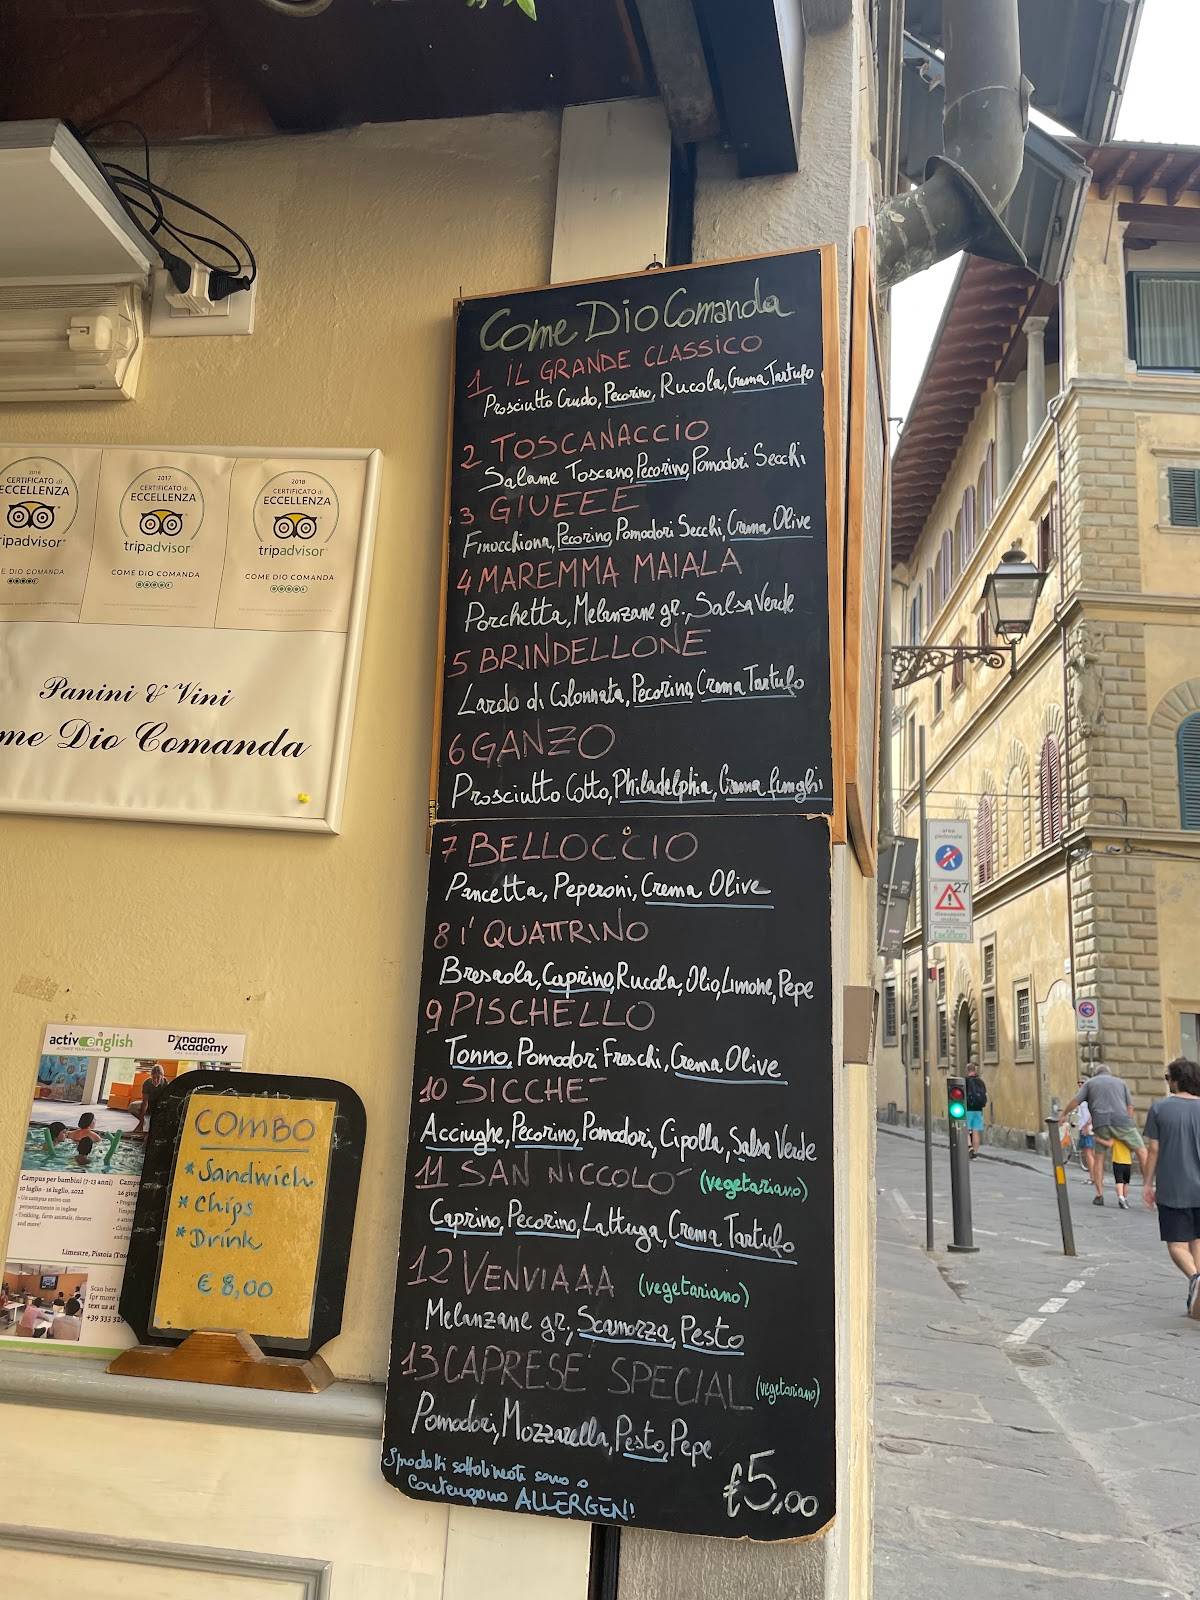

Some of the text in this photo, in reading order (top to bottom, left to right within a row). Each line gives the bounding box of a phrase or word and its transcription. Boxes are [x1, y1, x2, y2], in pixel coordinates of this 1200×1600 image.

[479, 277, 795, 352] Come Dio Comanda
[466, 369, 492, 398] 1
[540, 348, 631, 384] GRANDE
[644, 335, 762, 367] CLASSICO
[483, 388, 553, 417] Prosciutto
[557, 389, 602, 410] Crudo,
[660, 367, 727, 394] Rucola,
[764, 359, 814, 386] Tartufo
[460, 415, 708, 469] 2 TOSCANACCIO
[6, 476, 54, 484] CERTIFICATO
[478, 442, 806, 492] Salame Toscano, Pecorino, Pomodori Secchi
[130, 493, 196, 502] ECCELLENZA
[264, 496, 331, 505] ECCELLENZA
[459, 507, 474, 525] 3
[124, 540, 190, 554] tripadvisor
[259, 545, 324, 558] tripadvisor
[463, 526, 554, 558] Finocchiona,
[616, 515, 674, 542] Pomodori
[678, 512, 726, 542] Secchi,
[772, 505, 812, 531] Olive
[156, 570, 200, 578] COMANDA
[456, 548, 742, 595] 4 MAREMMA MAIALA
[465, 582, 795, 632] Porchetta, Melanzane Salsa Verde
[447, 623, 711, 678] 5 BRINDELLONE
[38, 676, 234, 707] Panini & Vini
[457, 682, 520, 716] Lardo
[527, 684, 544, 711] di
[743, 665, 805, 698] Tartufo
[57, 718, 128, 750] Dio
[135, 721, 312, 758] Comanda
[448, 718, 616, 768] 6 GANZO
[451, 772, 561, 808] Prosciutto
[566, 772, 613, 805] Cotto,
[440, 831, 698, 867] 7 BELLOCCIO
[445, 869, 771, 905] Pancetta, Peperoni, Crema Olive
[433, 907, 649, 949] 8 QUATTRINO
[439, 955, 540, 991] Bresaola,
[616, 961, 682, 997] Rucola,
[686, 966, 721, 1000] Olio,
[778, 968, 814, 1007] Pepe
[426, 991, 656, 1033] 9 PISCHELLO
[168, 1034, 216, 1044] Dynamo
[174, 1043, 228, 1054] Academy
[445, 1034, 782, 1078] Tonno, Pomodori Freschi, Crema Olive
[418, 1078, 447, 1104] 10
[195, 1109, 316, 1142] COMBO
[420, 1110, 817, 1162] Acciughe, Pecorino, Pomodori, Cipolla, Salsa Verde
[199, 1159, 314, 1186] Sandwich
[414, 1156, 448, 1189] 11
[457, 1150, 531, 1189] SAN
[699, 1167, 809, 1202] (vegetariano)
[194, 1192, 254, 1226] Chips
[429, 1198, 796, 1257] Caprino, Pecorino, Lattuga, Crema Tartufo
[62, 1249, 90, 1258] Limestre,
[190, 1228, 263, 1250] Drink
[197, 1273, 273, 1299] € 8,00
[407, 1246, 751, 1308] 12 VENVIAAA (vegetariano)
[425, 1298, 534, 1331] Melanzane
[680, 1318, 745, 1350] Pesto
[399, 1342, 440, 1382] 13
[607, 1357, 755, 1411] SPECIAL
[756, 1377, 821, 1408] (vegetariano)
[410, 1391, 713, 1468] Pomodori, Mozzarella, Pesto, Pepe
[535, 1471, 569, 1485] sono
[577, 1479, 589, 1488] o
